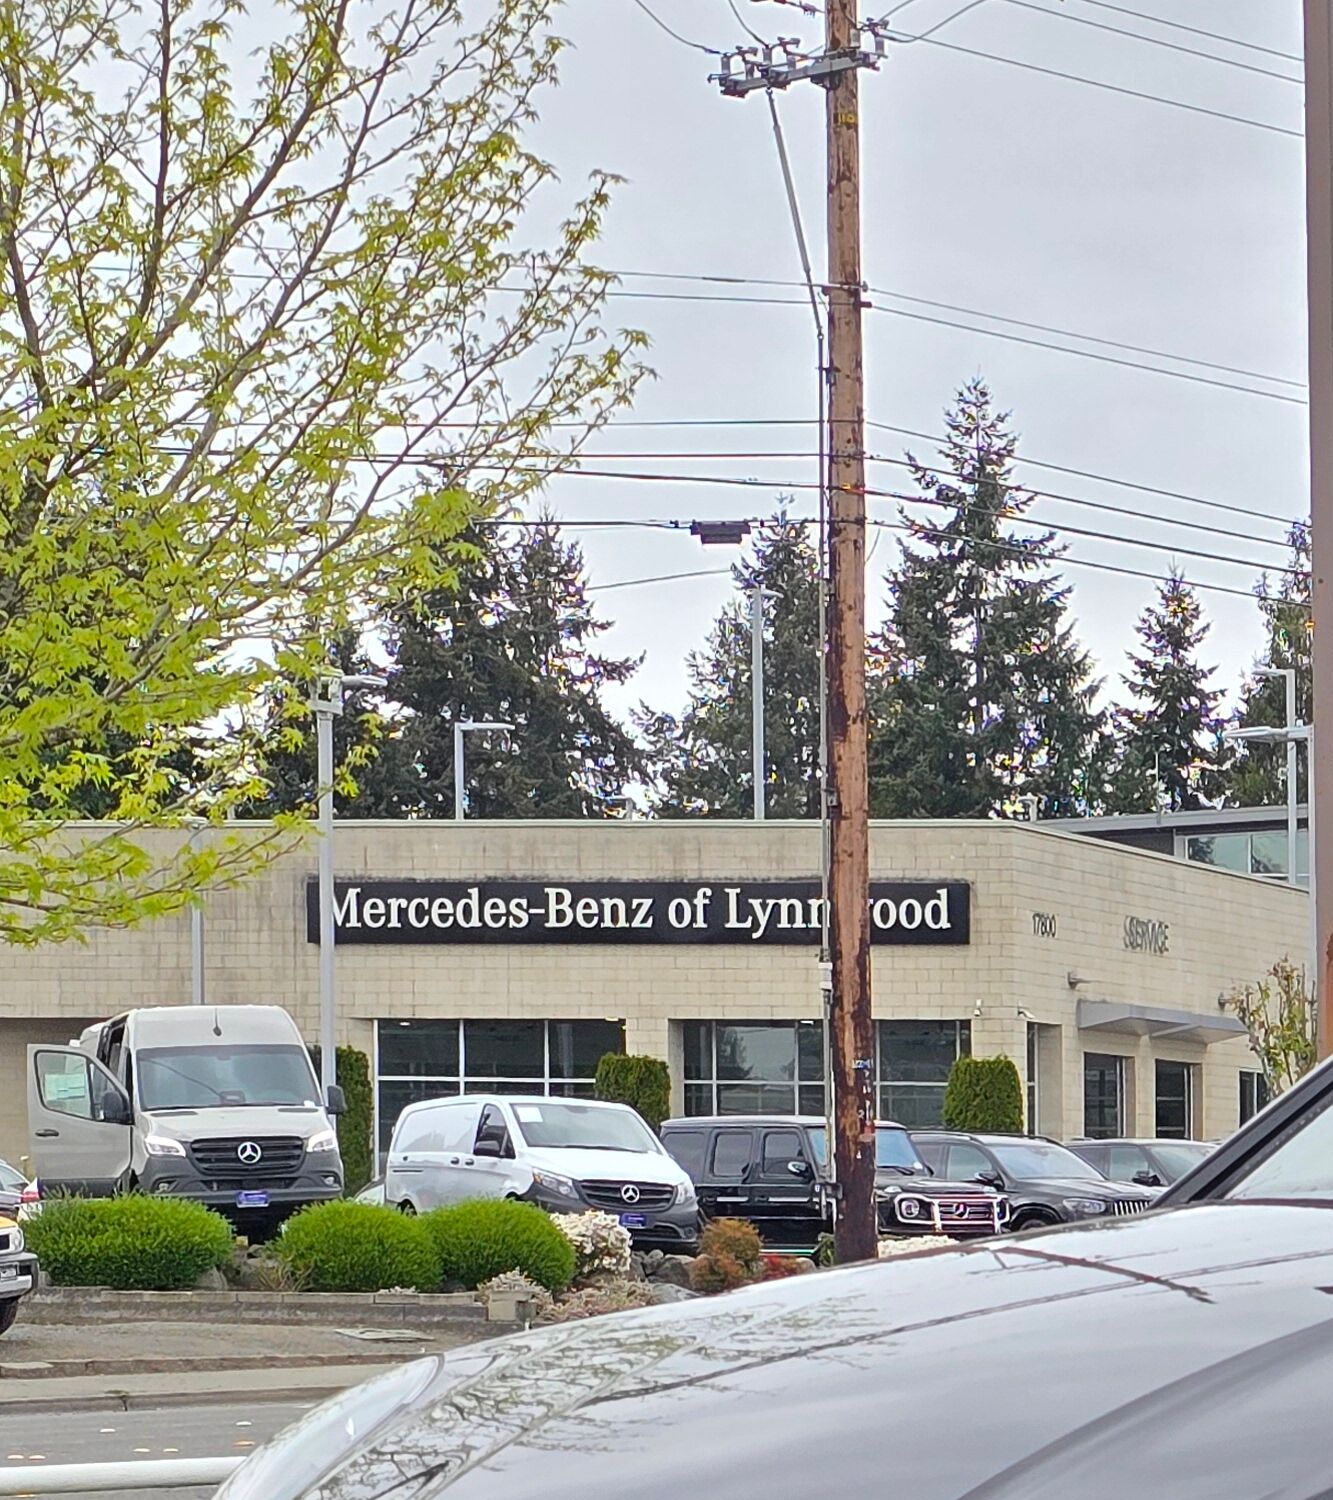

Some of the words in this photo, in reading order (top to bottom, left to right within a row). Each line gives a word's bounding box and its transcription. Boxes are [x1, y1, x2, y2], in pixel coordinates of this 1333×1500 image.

[332, 888, 653, 928] Mercedes-Benz
[668, 888, 712, 928] of
[724, 888, 951, 939] Lynnood
[1032, 912, 1056, 938] 17800
[1123, 915, 1169, 954] SERVICE
